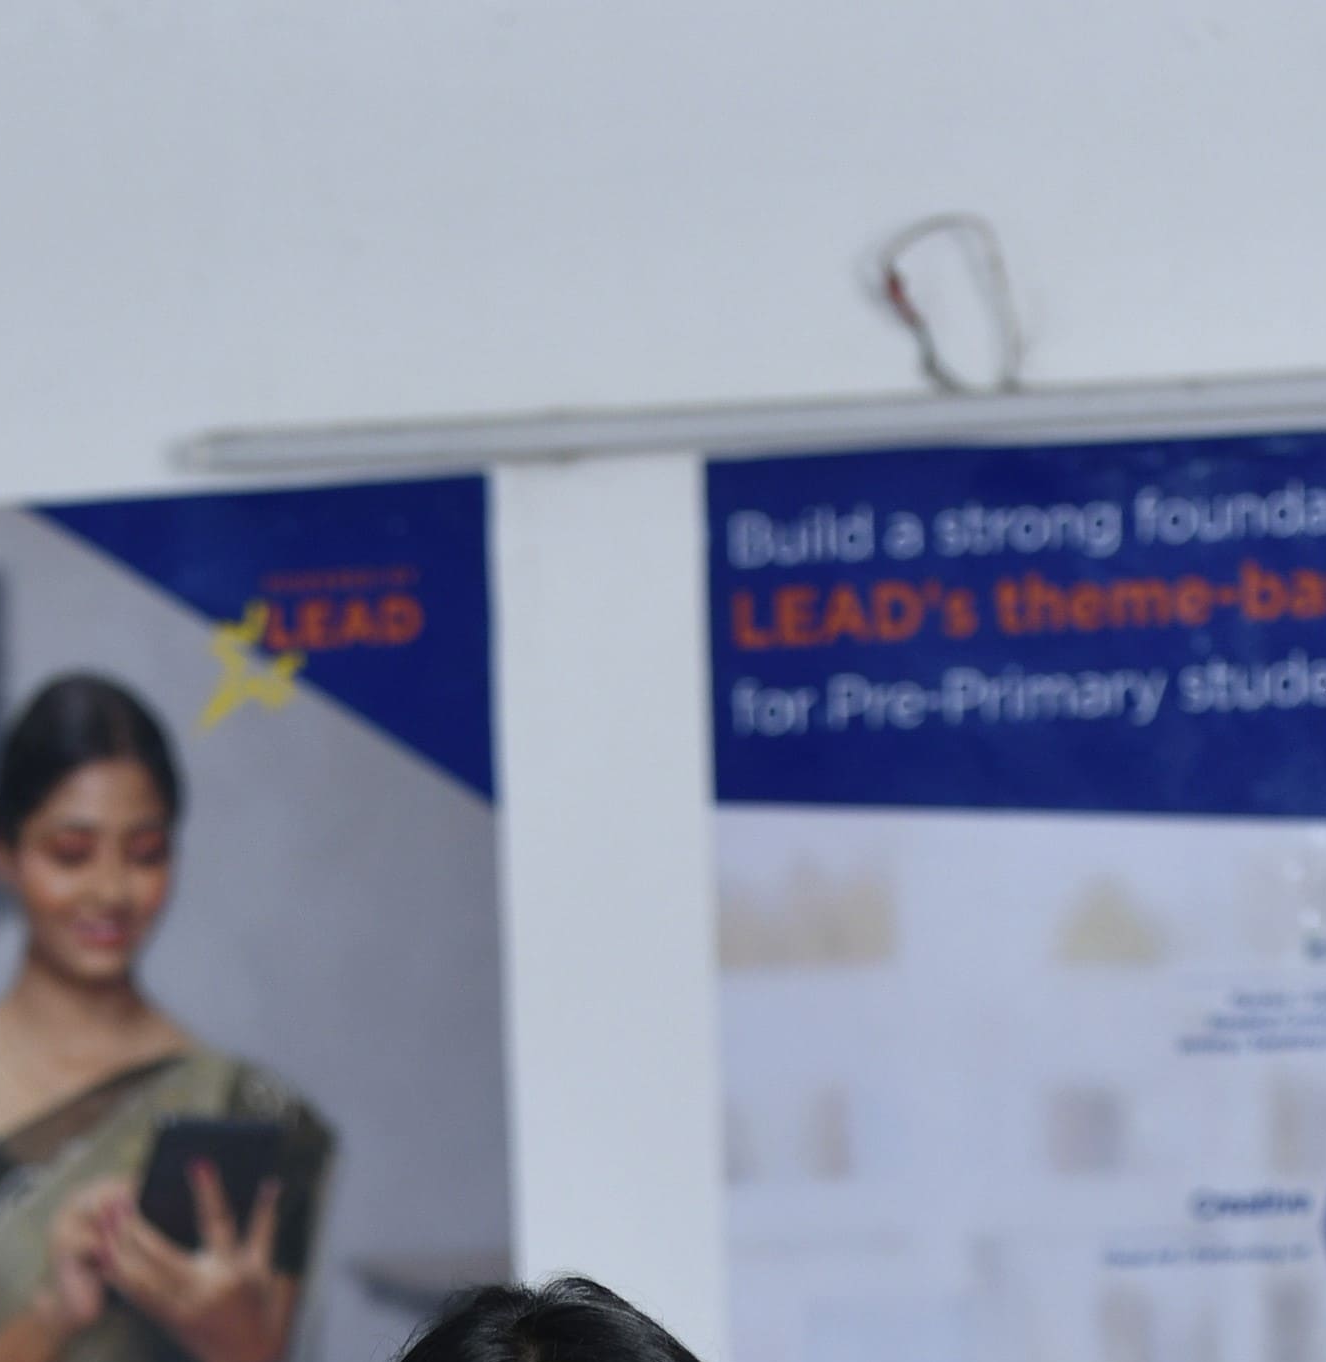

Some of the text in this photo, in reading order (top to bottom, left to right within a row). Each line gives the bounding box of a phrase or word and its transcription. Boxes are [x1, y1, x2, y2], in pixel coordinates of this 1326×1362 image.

[727, 506, 874, 569] Build
[884, 511, 924, 559] a
[934, 503, 1122, 557] strong
[265, 594, 425, 651] LEAD
[732, 581, 977, 650] LEAD's
[732, 678, 817, 736] for
[828, 667, 1168, 726] Pre-Primary
